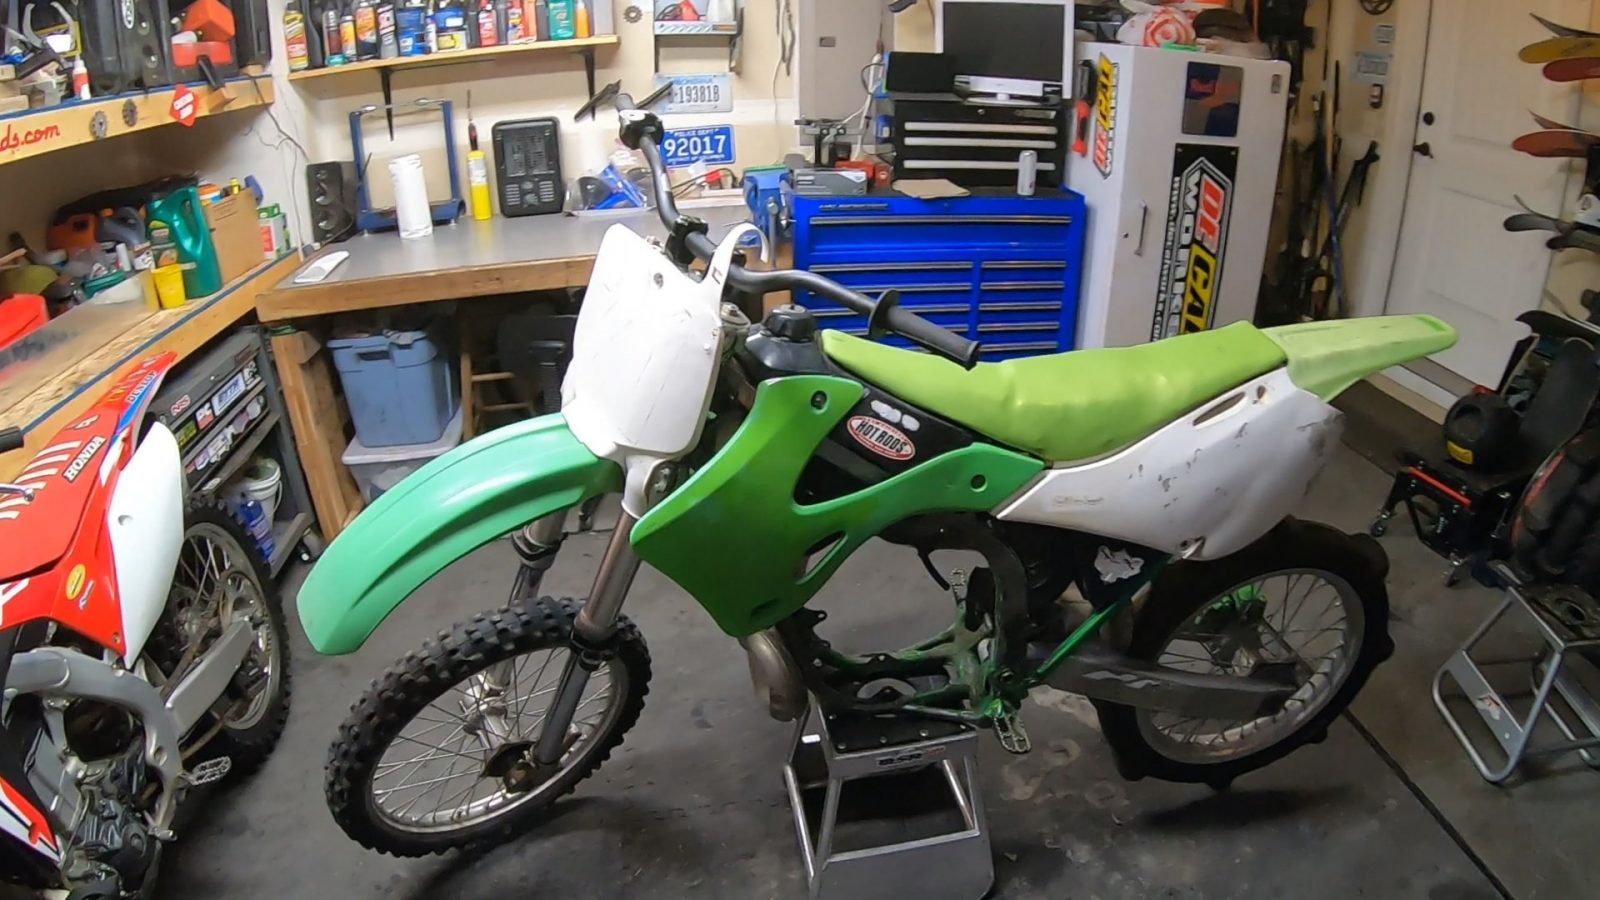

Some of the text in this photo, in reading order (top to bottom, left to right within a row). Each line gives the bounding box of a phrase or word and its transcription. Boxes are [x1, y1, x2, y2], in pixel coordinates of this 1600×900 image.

[664, 135, 726, 157] 92017
[856, 419, 880, 439] HOT
[875, 430, 907, 453] RODS
[62, 435, 107, 482] HONDA
